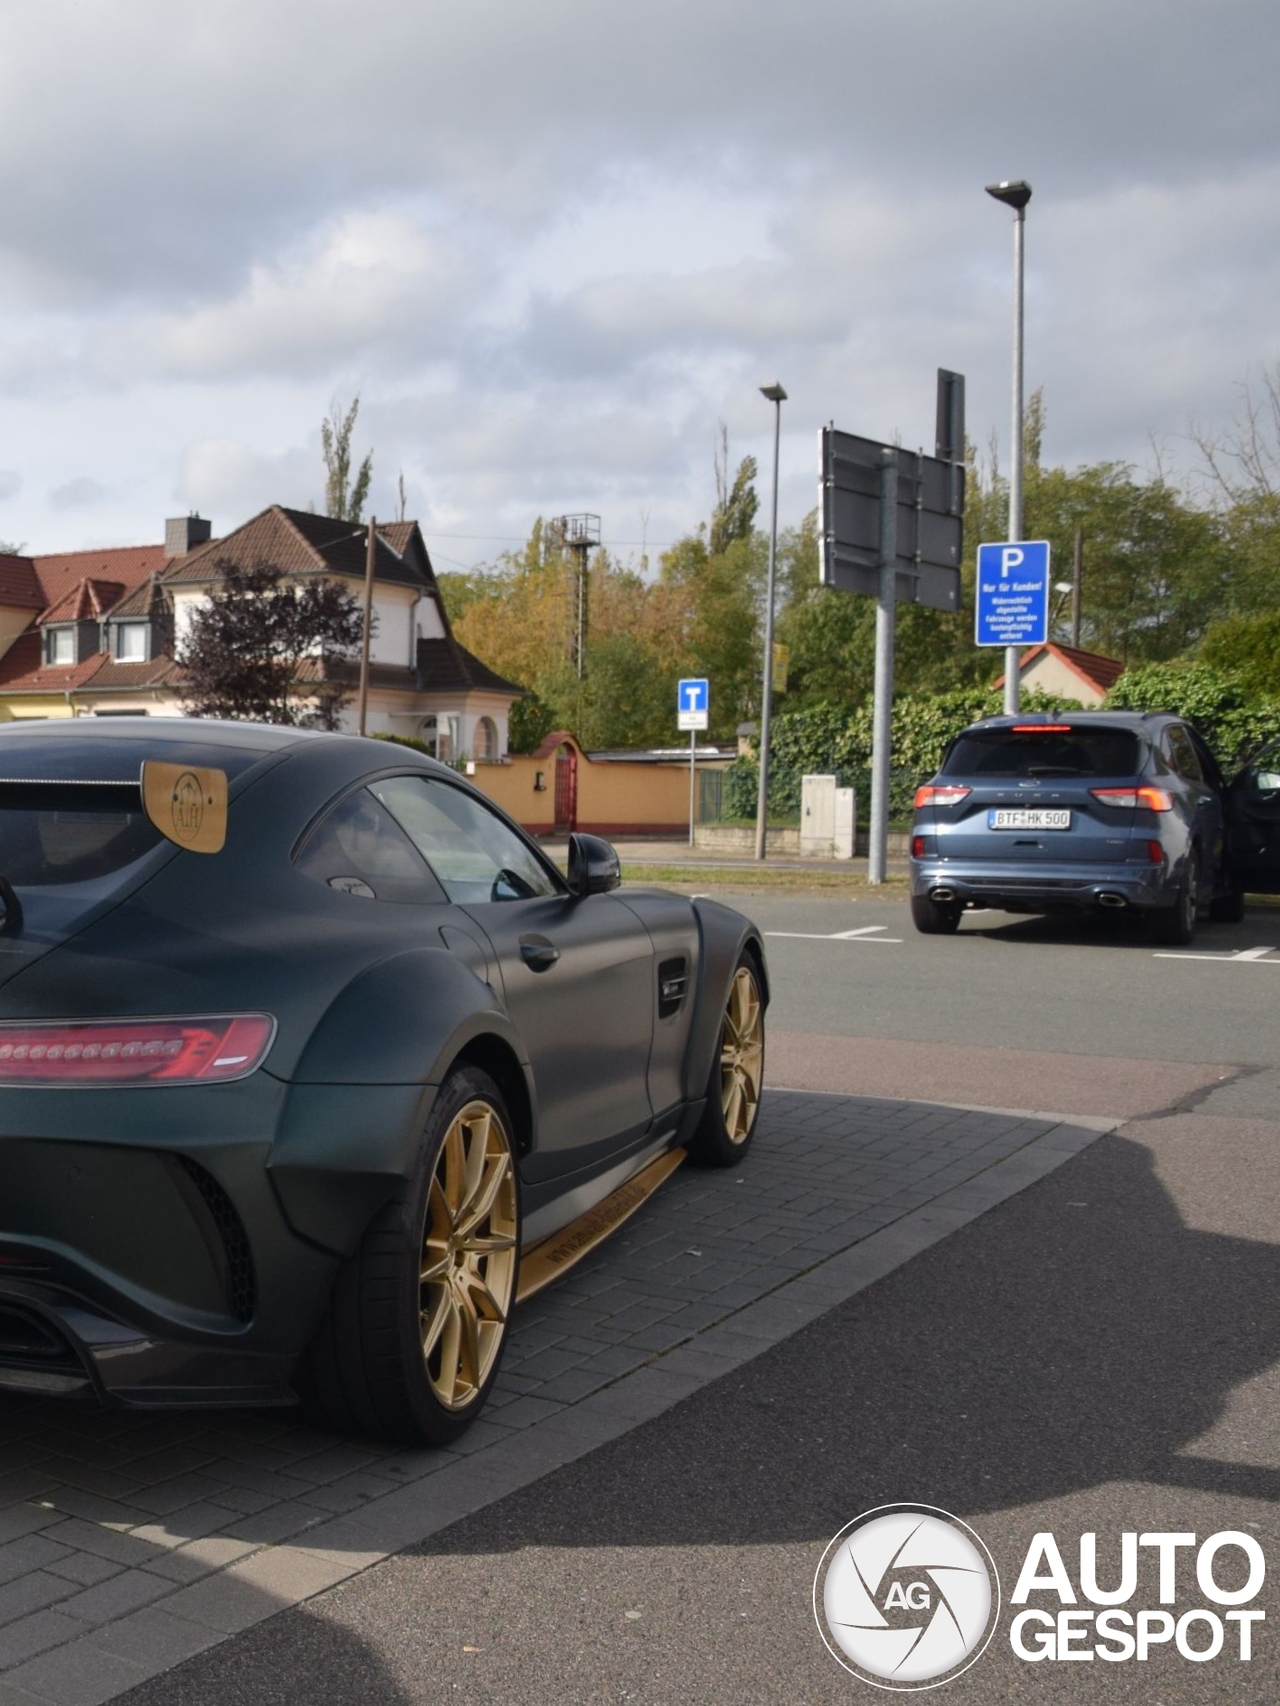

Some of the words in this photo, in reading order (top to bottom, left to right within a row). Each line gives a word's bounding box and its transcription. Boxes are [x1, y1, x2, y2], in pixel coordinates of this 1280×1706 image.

[1001, 548, 1024, 578] P
[997, 812, 1019, 825] BTF
[1027, 812, 1042, 825] HK
[1045, 812, 1068, 825] 500
